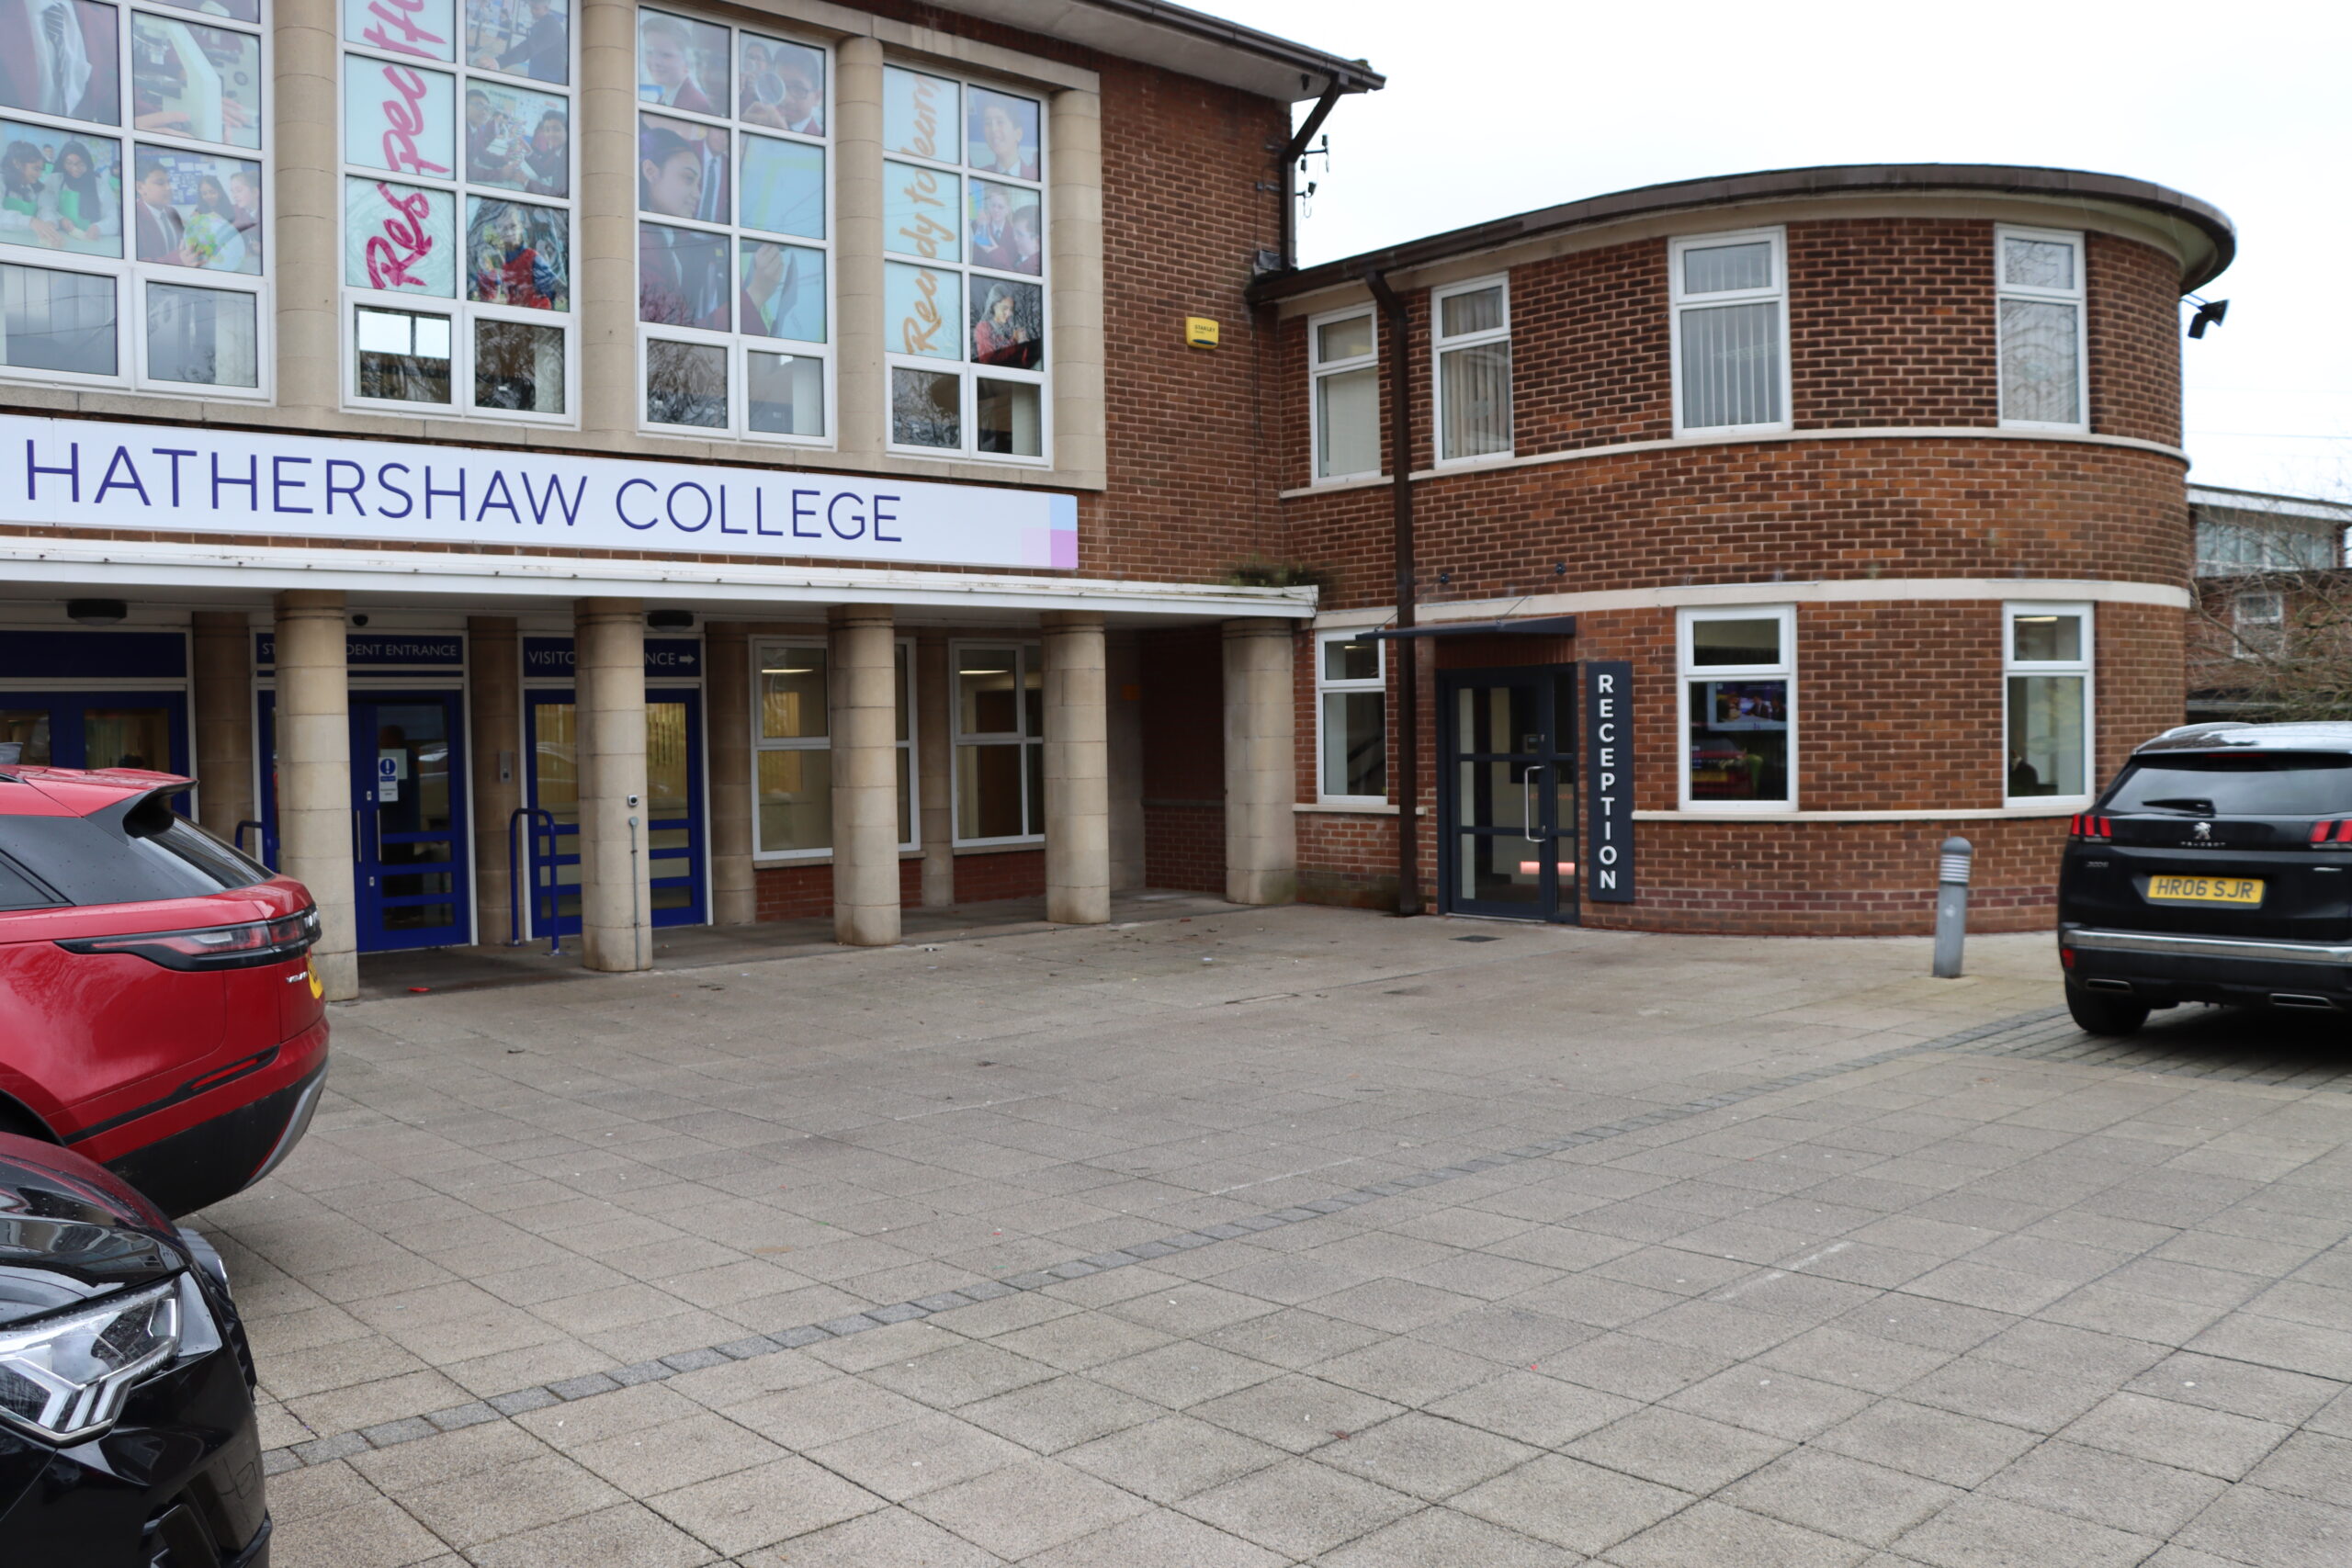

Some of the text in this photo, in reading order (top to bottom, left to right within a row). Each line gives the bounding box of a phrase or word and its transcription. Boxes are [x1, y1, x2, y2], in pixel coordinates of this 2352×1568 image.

[899, 73, 956, 355] Ready to learn
[27, 439, 902, 542] HATHERSHAW COLLEGE
[346, 644, 458, 657] DENT ENTRANCE
[528, 650, 575, 665] VISITO
[1598, 674, 1617, 889] RECEPTION
[2156, 878, 2254, 898] HR06 SJR
